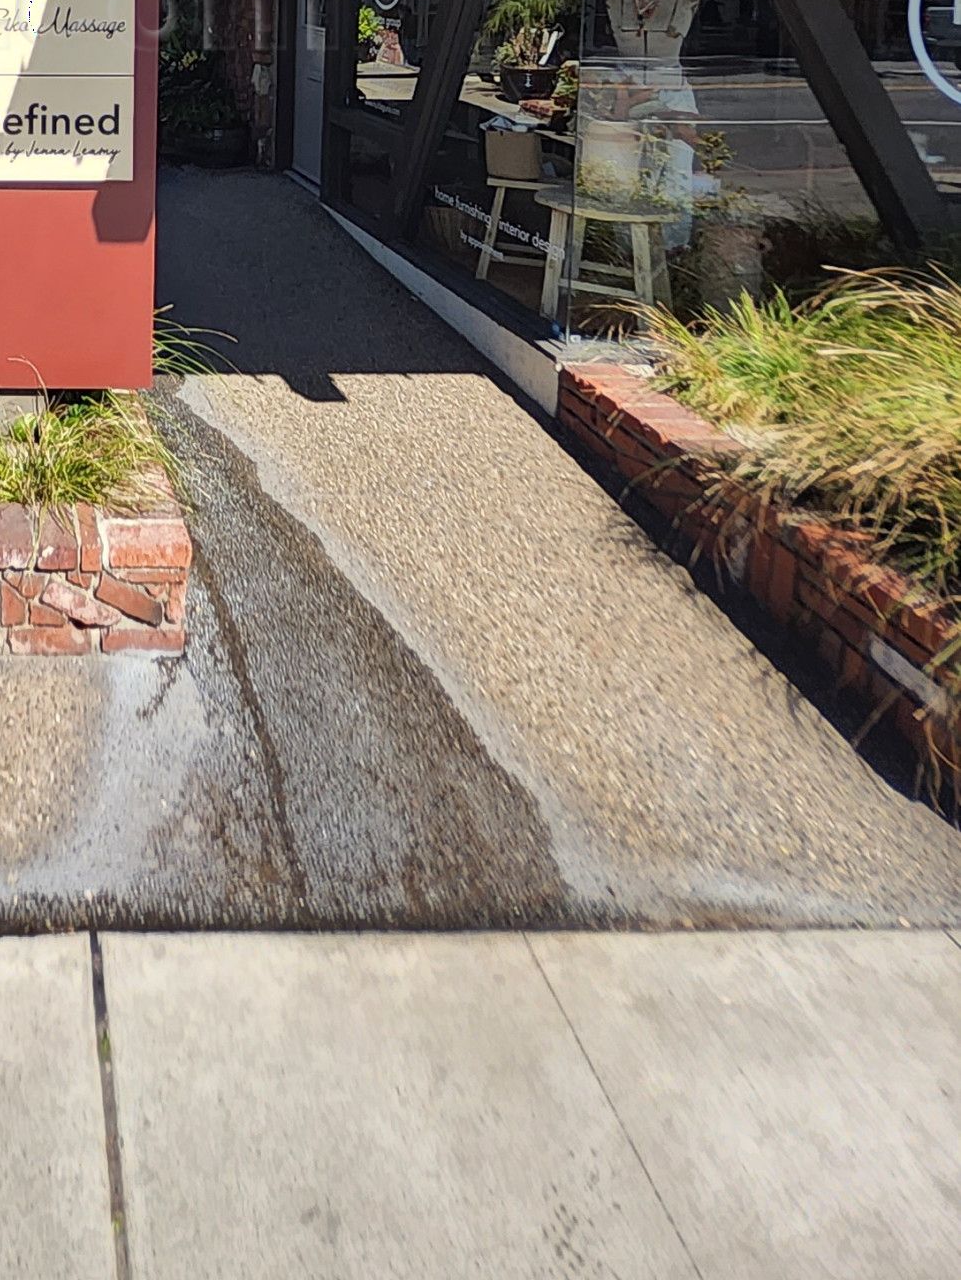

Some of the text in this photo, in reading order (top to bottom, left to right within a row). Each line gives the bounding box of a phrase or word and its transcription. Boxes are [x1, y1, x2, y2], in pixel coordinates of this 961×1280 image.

[37, 6, 127, 39] Massage
[5, 141, 24, 163] by
[26, 139, 71, 158] Jenna
[434, 184, 454, 207] home
[498, 216, 529, 242] interior
